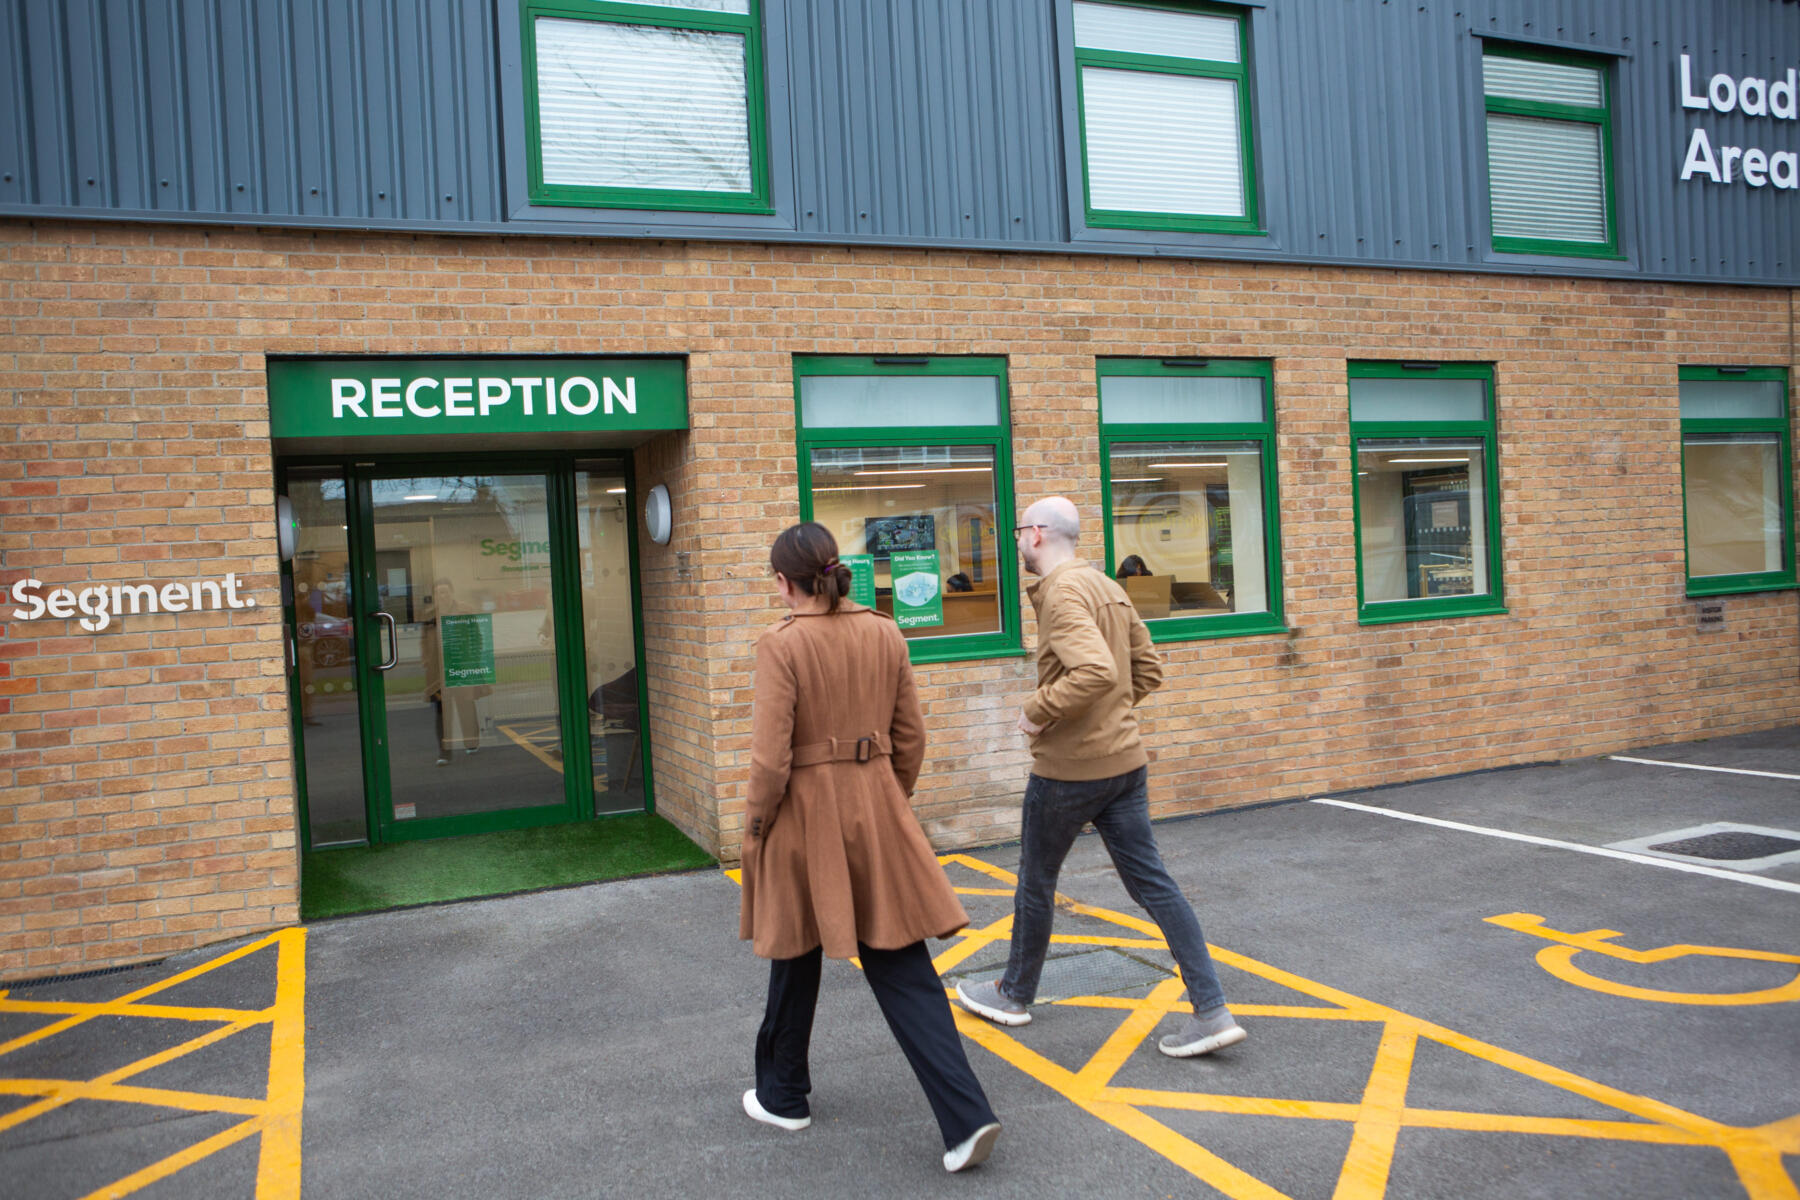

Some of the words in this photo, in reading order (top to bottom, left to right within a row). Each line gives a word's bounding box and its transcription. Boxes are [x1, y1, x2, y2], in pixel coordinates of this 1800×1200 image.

[1680, 54, 1800, 119] Load
[1680, 128, 1798, 189] Area
[331, 376, 637, 418] RECEPTION
[481, 538, 551, 561] Segme
[916, 553, 935, 561] Know?
[12, 572, 256, 632] Segment.
[898, 613, 940, 626] Segment.
[448, 666, 492, 678] Segment.
